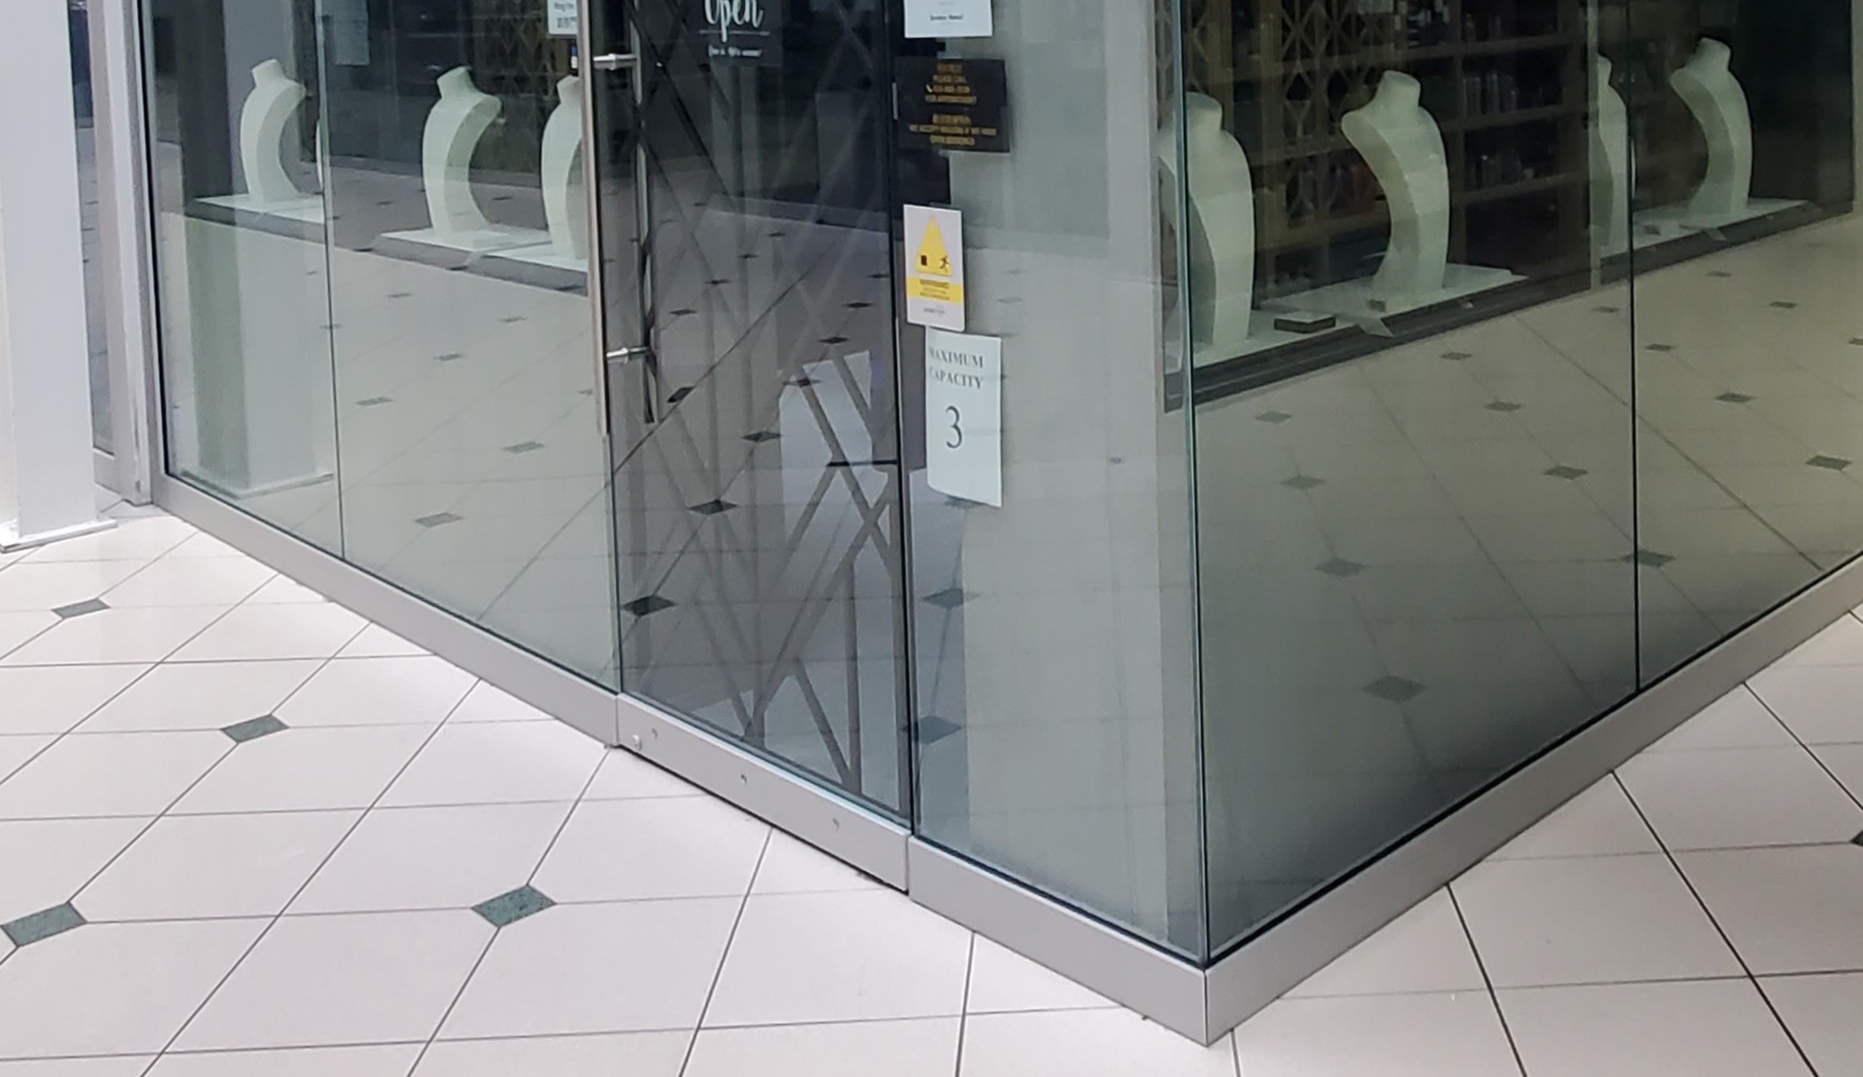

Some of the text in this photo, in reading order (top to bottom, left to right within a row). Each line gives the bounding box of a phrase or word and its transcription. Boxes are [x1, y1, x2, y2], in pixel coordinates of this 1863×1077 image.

[929, 346, 985, 369] MAXIMUM
[929, 366, 983, 390] CAPACITY
[945, 405, 963, 449] 3
